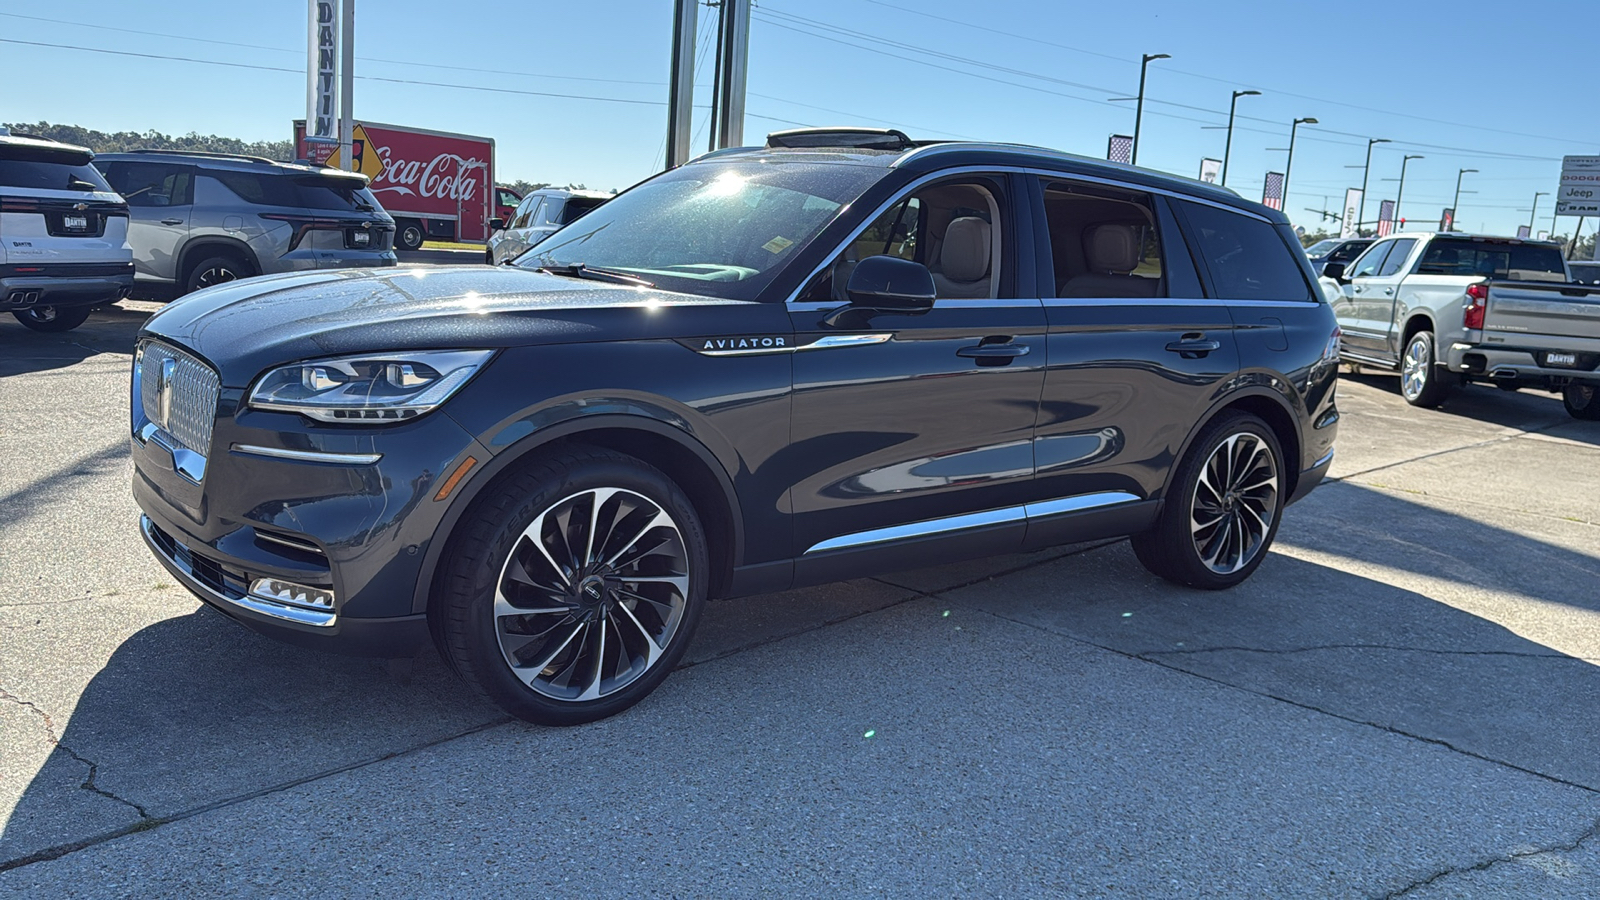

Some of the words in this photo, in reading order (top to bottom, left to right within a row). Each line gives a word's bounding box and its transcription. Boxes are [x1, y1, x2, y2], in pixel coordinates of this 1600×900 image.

[315, 2, 334, 136] DANTIN
[1566, 188, 1593, 199] Jeep
[64, 217, 87, 227] DANTIN
[1344, 207, 1355, 234] Jeep
[703, 337, 786, 349] AVIATOR
[1547, 353, 1575, 365] DANTIN
[495, 490, 546, 550] ZERO
